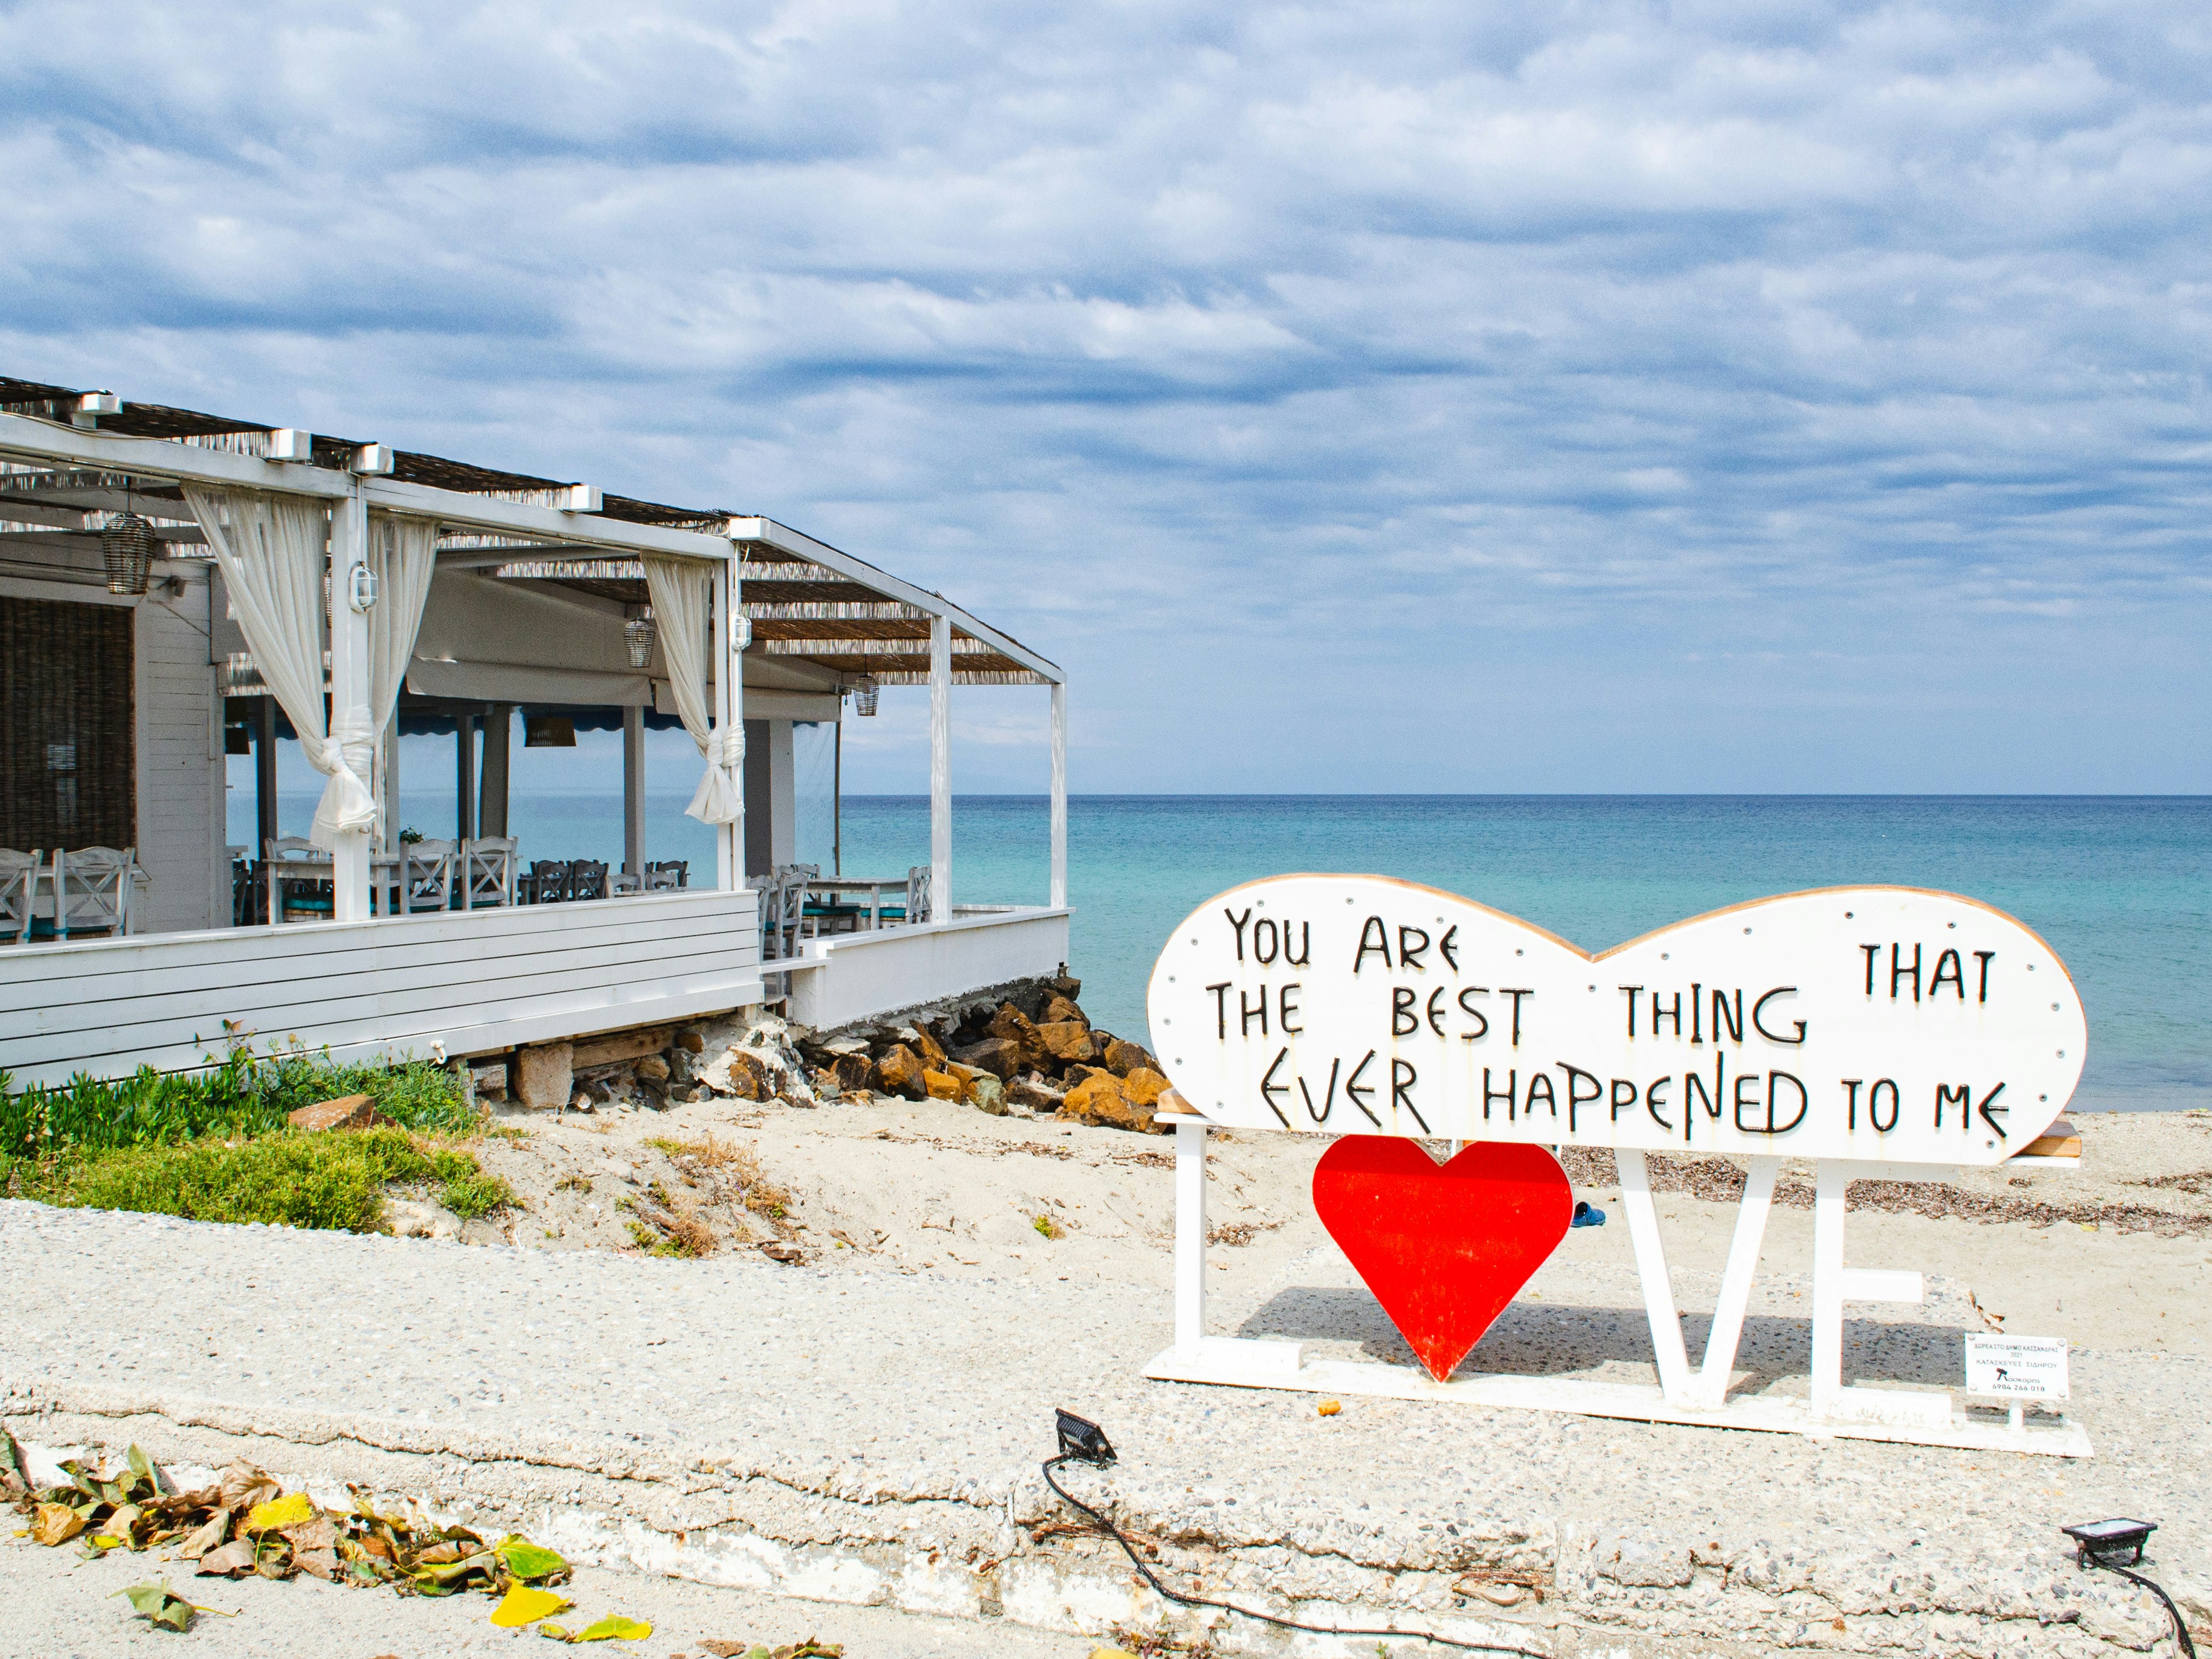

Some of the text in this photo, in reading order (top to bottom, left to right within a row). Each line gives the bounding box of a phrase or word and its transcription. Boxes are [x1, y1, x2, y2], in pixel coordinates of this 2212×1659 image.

[1224, 907, 1459, 973] YOU ARE
[1205, 942, 1996, 1045] THE BEST THING THAT
[1261, 1047, 2010, 1141] EVER HAPPENED TO ME
[1976, 1359, 2022, 1367] ΚΑΤΑΣΚΕΥΕΣ
